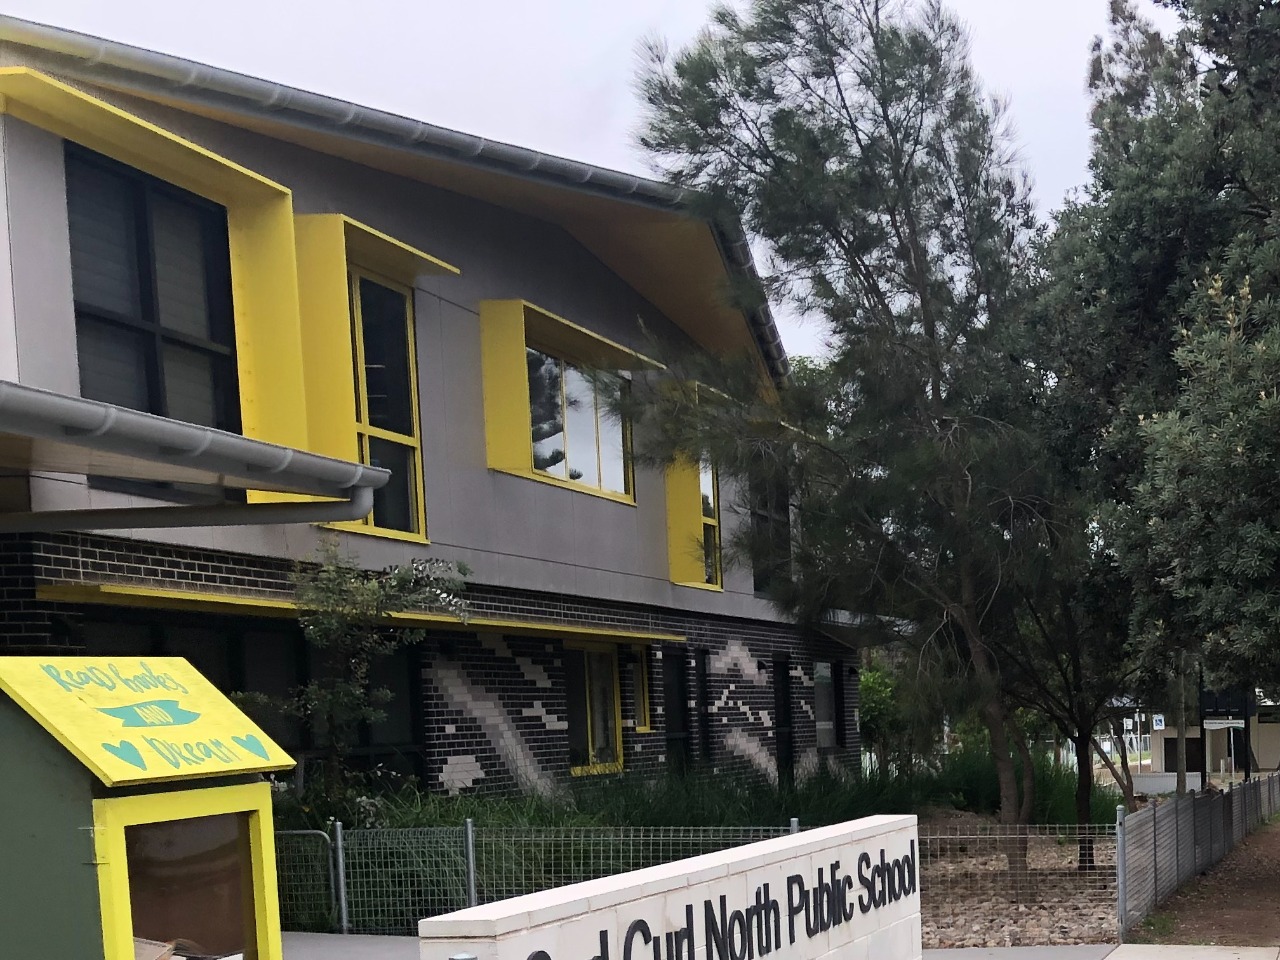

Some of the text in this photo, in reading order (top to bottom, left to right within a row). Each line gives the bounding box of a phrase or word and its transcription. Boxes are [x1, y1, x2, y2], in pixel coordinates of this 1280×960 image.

[133, 704, 174, 725] AND
[786, 860, 855, 945] Public
[858, 839, 916, 914] School
